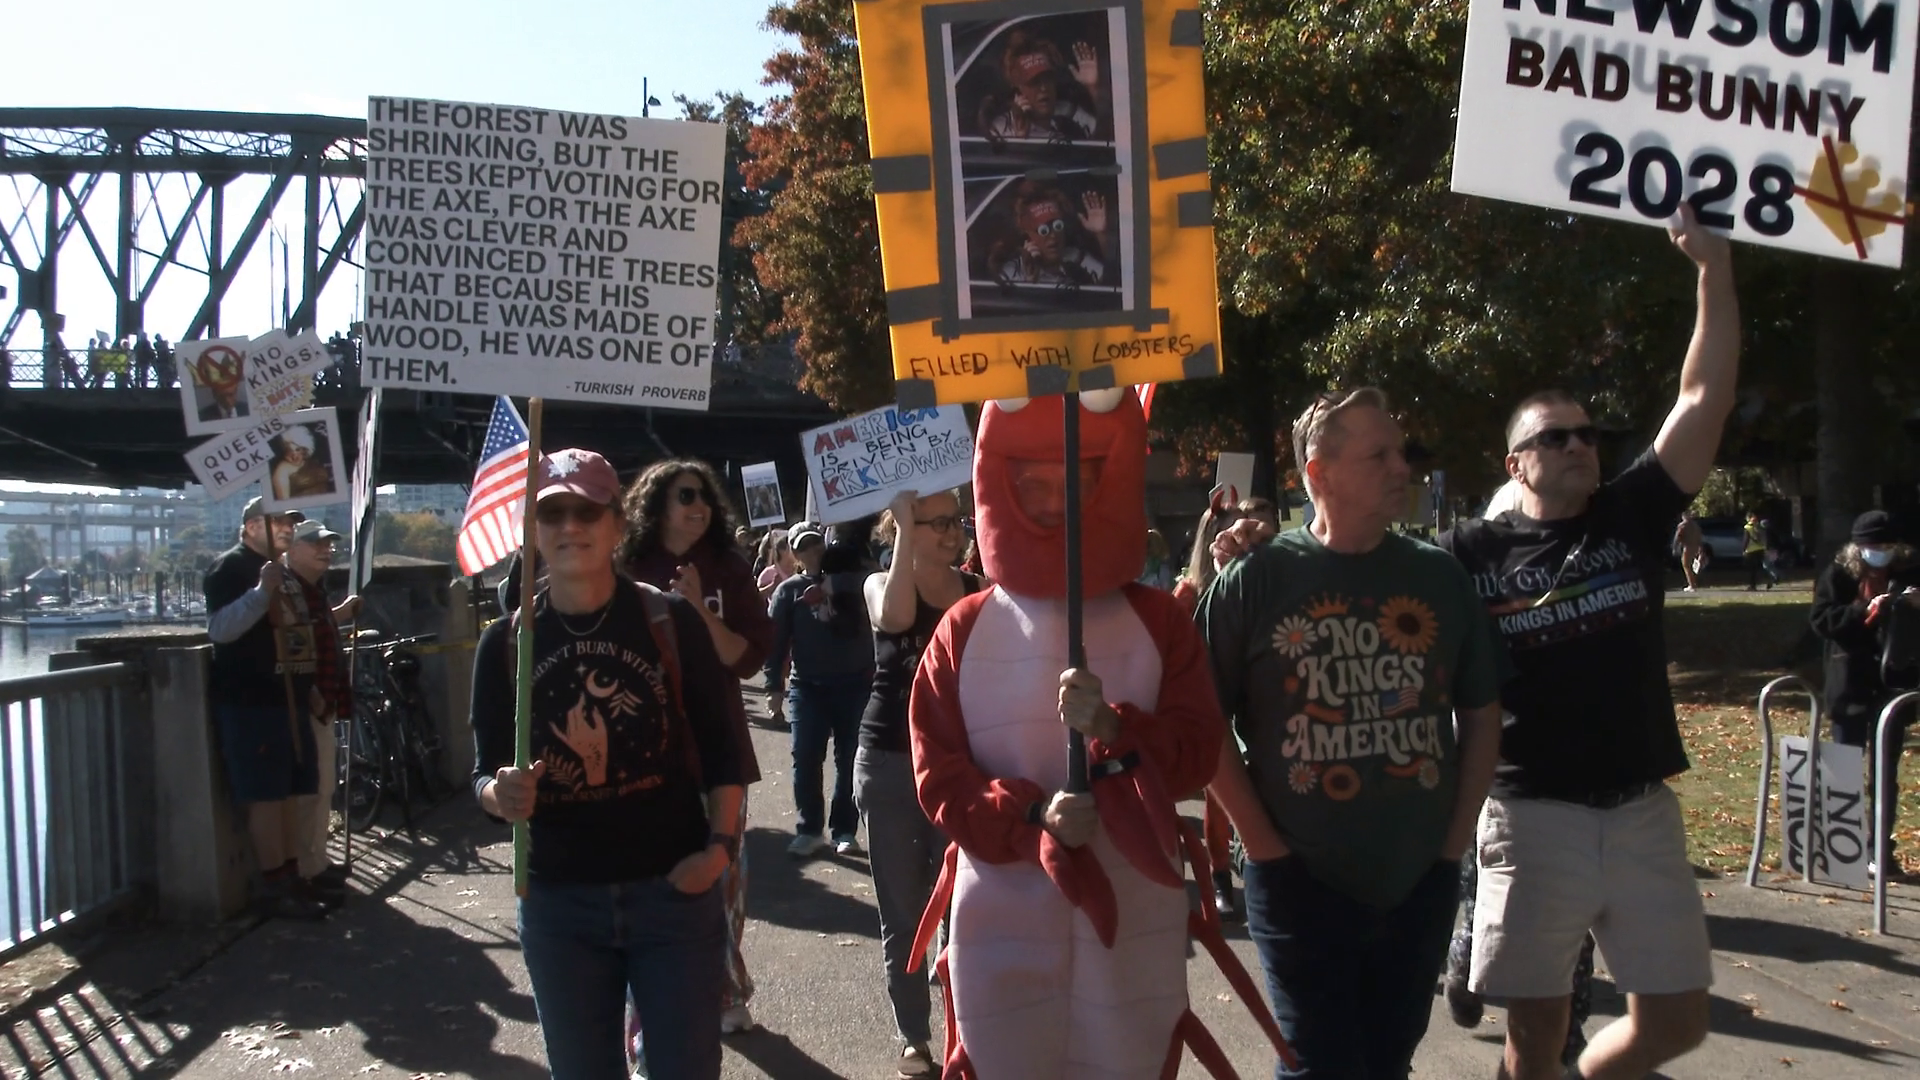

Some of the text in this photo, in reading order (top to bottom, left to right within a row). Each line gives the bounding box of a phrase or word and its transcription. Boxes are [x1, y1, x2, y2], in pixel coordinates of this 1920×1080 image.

[1502, 0, 1897, 74] WSOM
[1506, 37, 1866, 143] BAD BUNNY
[370, 101, 628, 140] THE FOREST WAS
[369, 129, 678, 174] SHRINKING, BUT THE
[370, 157, 721, 204] TREES KEPT VOTING FOR
[1569, 132, 1794, 237] 2028
[368, 185, 696, 232] THE AXE, FOR THE AXE
[369, 214, 628, 253] WAS CLEVER AND
[366, 240, 715, 288] CONVINCED THE TREES
[370, 269, 649, 309] THAT BECAUSE HIS
[368, 297, 706, 339] HANDLE WAS MADE OF
[252, 346, 282, 367] NO
[364, 324, 710, 367] WOOD, HE WAS ONE OF
[910, 334, 1194, 379] FILLED WITH LOBSTERS
[248, 348, 320, 389] KINGS.
[367, 357, 457, 384] THEM.
[642, 386, 706, 401] PROVERB
[204, 418, 284, 470] QUEENS
[814, 407, 939, 456] AMERICA
[821, 424, 927, 467] IS BEING
[822, 429, 952, 479] DRIVEN BY
[213, 449, 269, 485] R O.K.
[822, 437, 974, 500] KKKLOWNS
[1499, 579, 1647, 635] KINGS IN AMERICA
[576, 641, 618, 656] BURN
[1317, 617, 1380, 657] NO
[1297, 654, 1425, 706] KINGS
[1352, 694, 1381, 720] IN
[1282, 714, 1444, 765] AMERICA
[1827, 786, 1862, 864] NO
